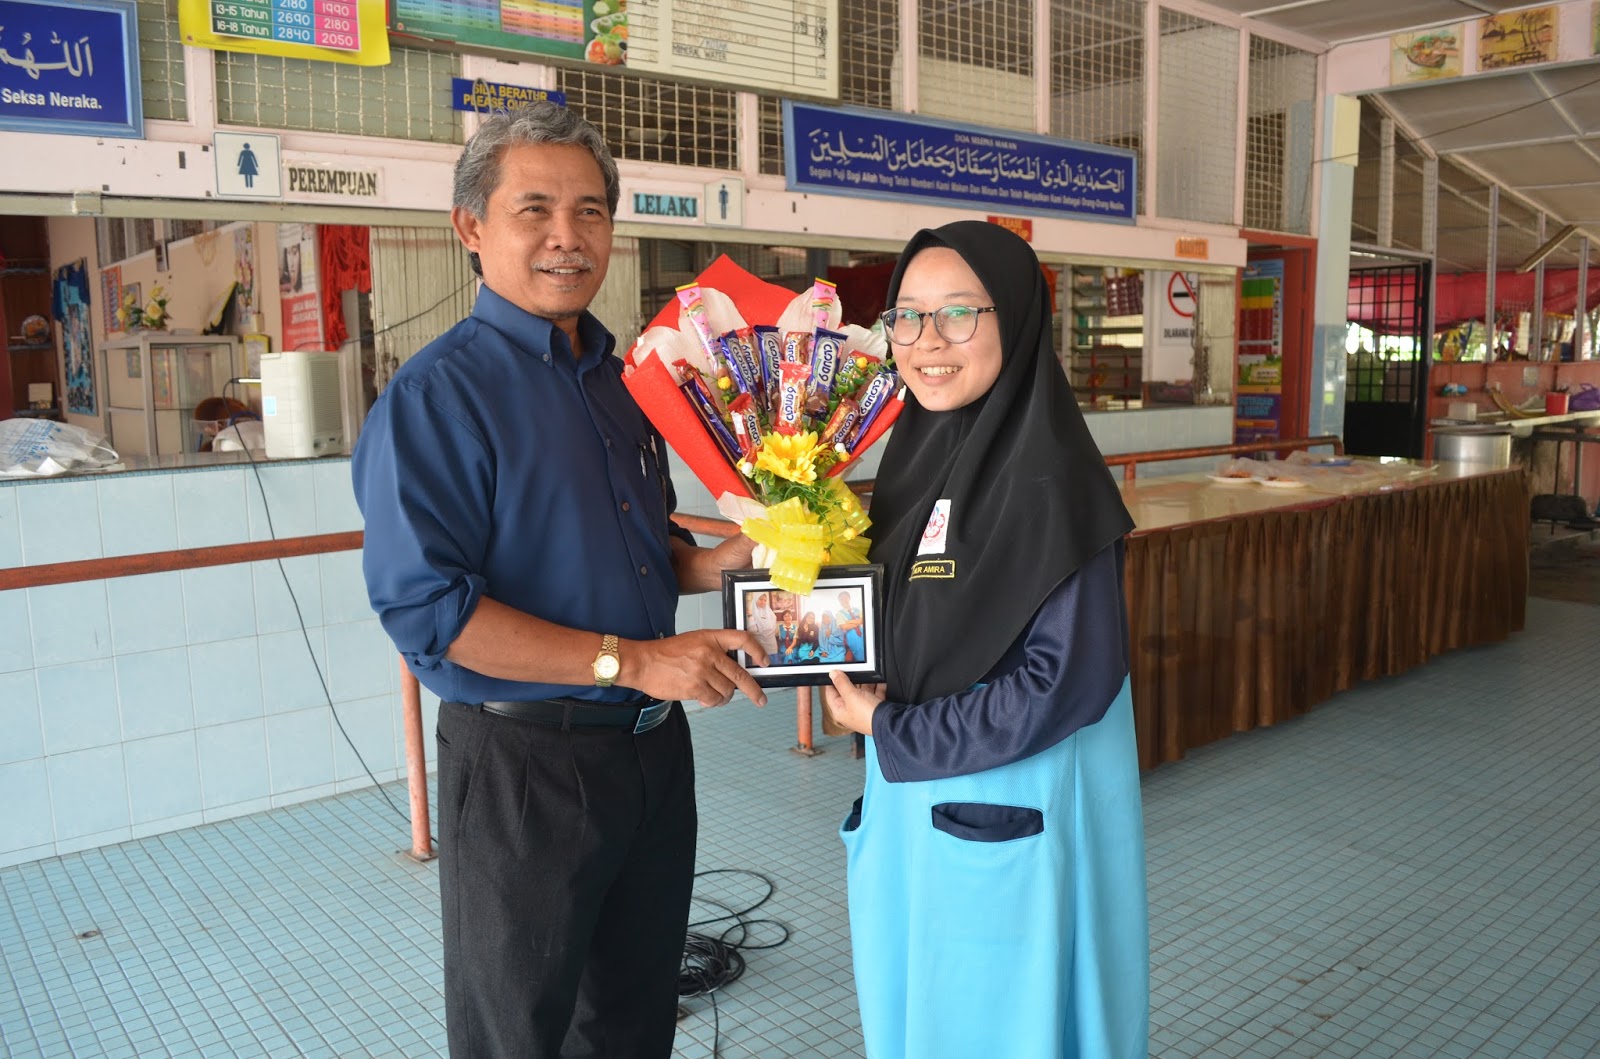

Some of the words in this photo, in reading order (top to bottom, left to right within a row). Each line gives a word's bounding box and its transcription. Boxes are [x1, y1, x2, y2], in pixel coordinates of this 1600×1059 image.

[216, 5, 238, 16] 13-15
[240, 8, 269, 20] Tahun
[278, 12, 310, 26] 2690
[324, 16, 350, 30] 2180
[323, 1, 349, 15] 1990
[217, 20, 239, 32] 16-18
[240, 23, 269, 36] Tahun
[278, 27, 310, 41] 2840
[322, 32, 353, 47] 2050
[2, 88, 46, 106] Seksa
[50, 91, 102, 109] Neraka.
[463, 94, 504, 109] PLEASE
[475, 84, 496, 95] SILA
[499, 86, 547, 101] BERATUR
[288, 168, 377, 196] PEREMPUAN
[633, 193, 698, 218] LELAKI
